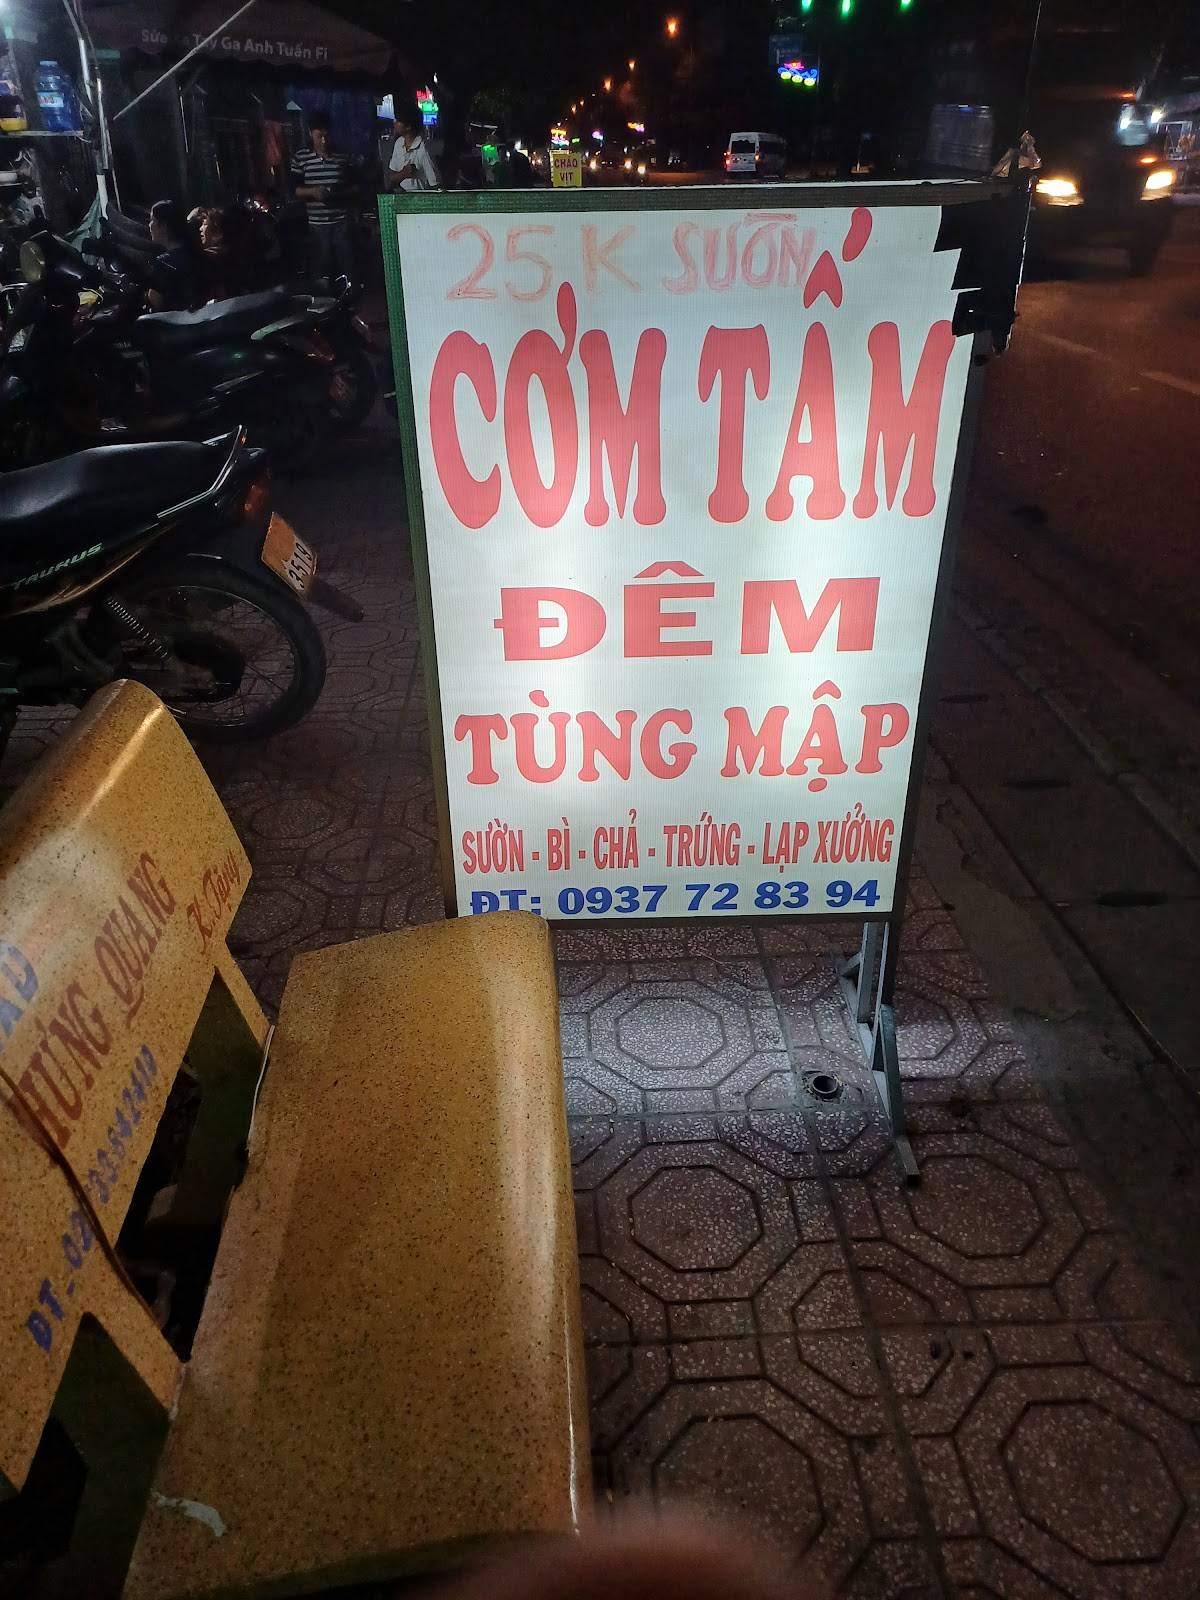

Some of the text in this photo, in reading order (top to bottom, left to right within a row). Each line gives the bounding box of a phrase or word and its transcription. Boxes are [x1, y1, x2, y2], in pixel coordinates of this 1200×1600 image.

[244, 38, 273, 55] Anh
[447, 222, 556, 302] 25
[429, 206, 957, 529] CƠM TẤM
[494, 561, 880, 661] ĐÊM
[454, 680, 910, 792] TÙNG MẬP
[462, 818, 525, 874] SƯỜN
[547, 816, 571, 871] BÌ
[593, 807, 639, 869] CHẢ
[663, 811, 741, 867] TRỨNG
[762, 821, 809, 873] LẠP
[813, 802, 895, 863] XƯỞNG
[95, 851, 177, 1028] QUANG
[557, 884, 668, 915] 0937
[685, 883, 740, 911] 72
[754, 881, 809, 909] 83
[825, 879, 880, 907] 94
